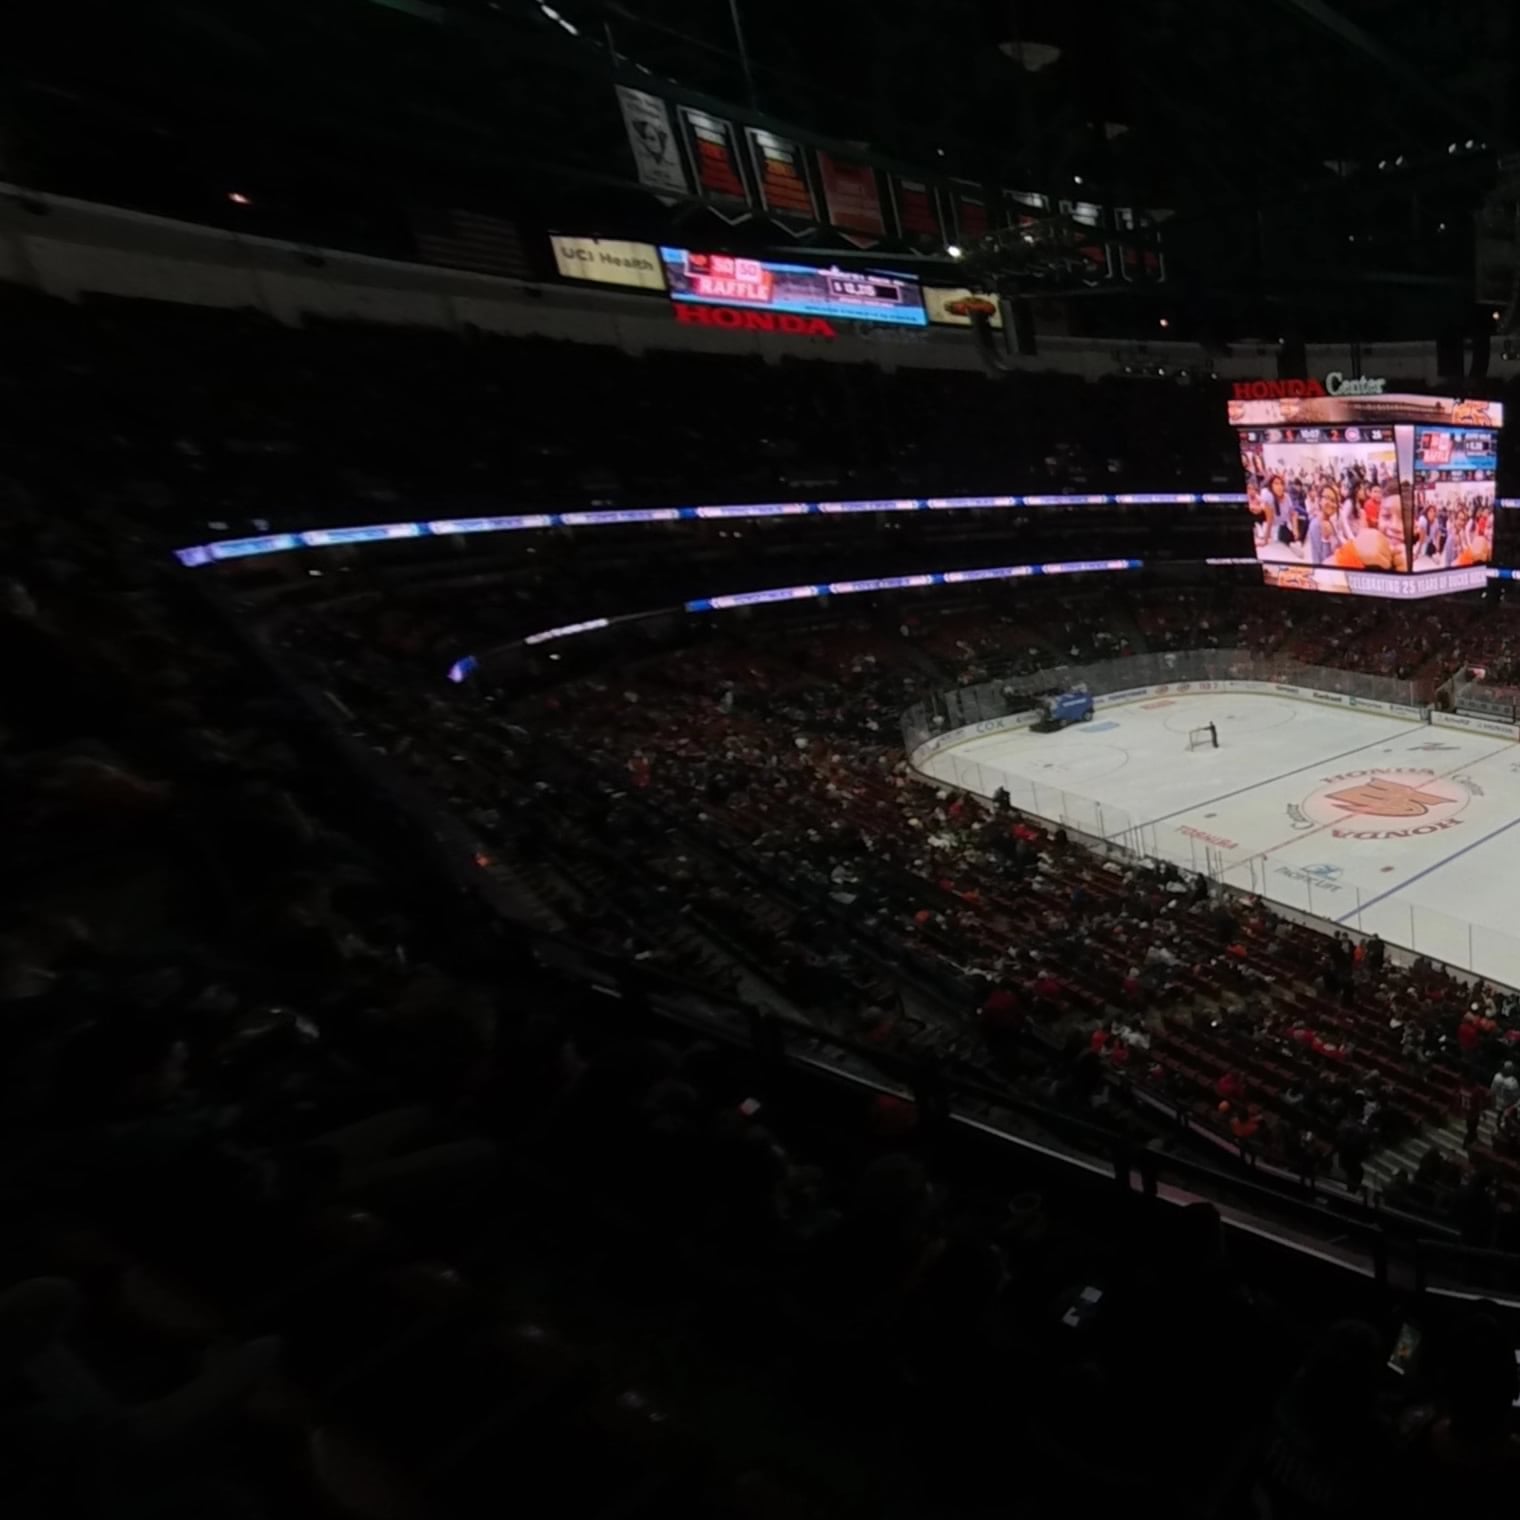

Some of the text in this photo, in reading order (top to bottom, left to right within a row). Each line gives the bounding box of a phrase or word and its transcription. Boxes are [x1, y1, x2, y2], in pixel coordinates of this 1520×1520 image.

[561, 247, 654, 271] UCI Health
[702, 278, 770, 301] RAFFLE
[673, 303, 837, 338] HONDA
[1233, 372, 1386, 399] HONDA Center
[1402, 580, 1416, 594] 25
[976, 720, 1004, 733] COX
[1320, 768, 1435, 784] HONDA
[1175, 825, 1239, 850] TOSHIBA
[1331, 817, 1464, 841] HONDA
